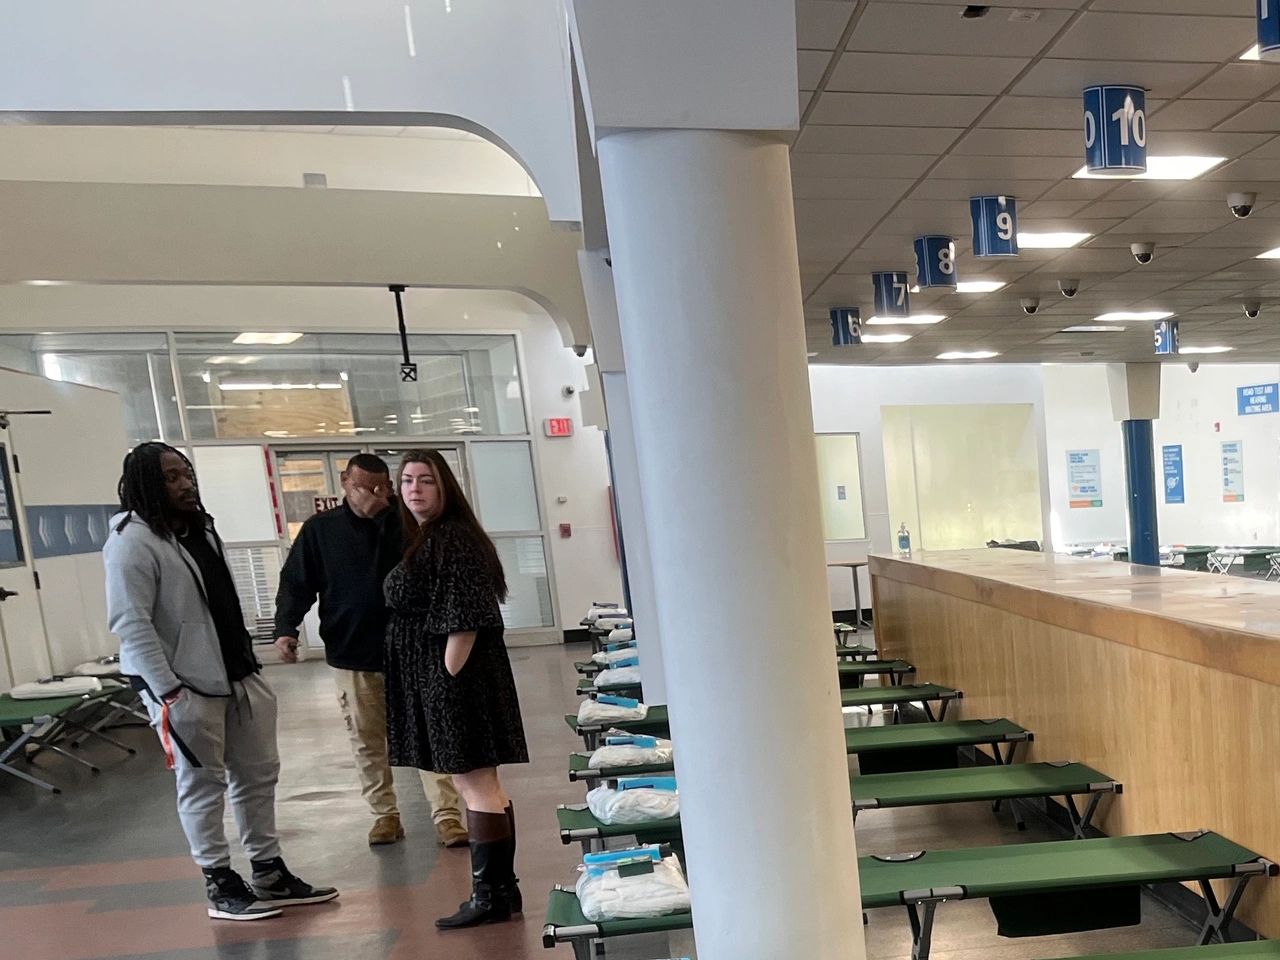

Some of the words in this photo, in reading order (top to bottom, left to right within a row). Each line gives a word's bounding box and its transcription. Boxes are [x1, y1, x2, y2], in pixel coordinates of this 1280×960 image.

[1111, 108, 1146, 148] 10
[996, 212, 1013, 240] 9
[937, 248, 954, 275] 8
[893, 283, 906, 306] 7
[1154, 329, 1162, 347] 5
